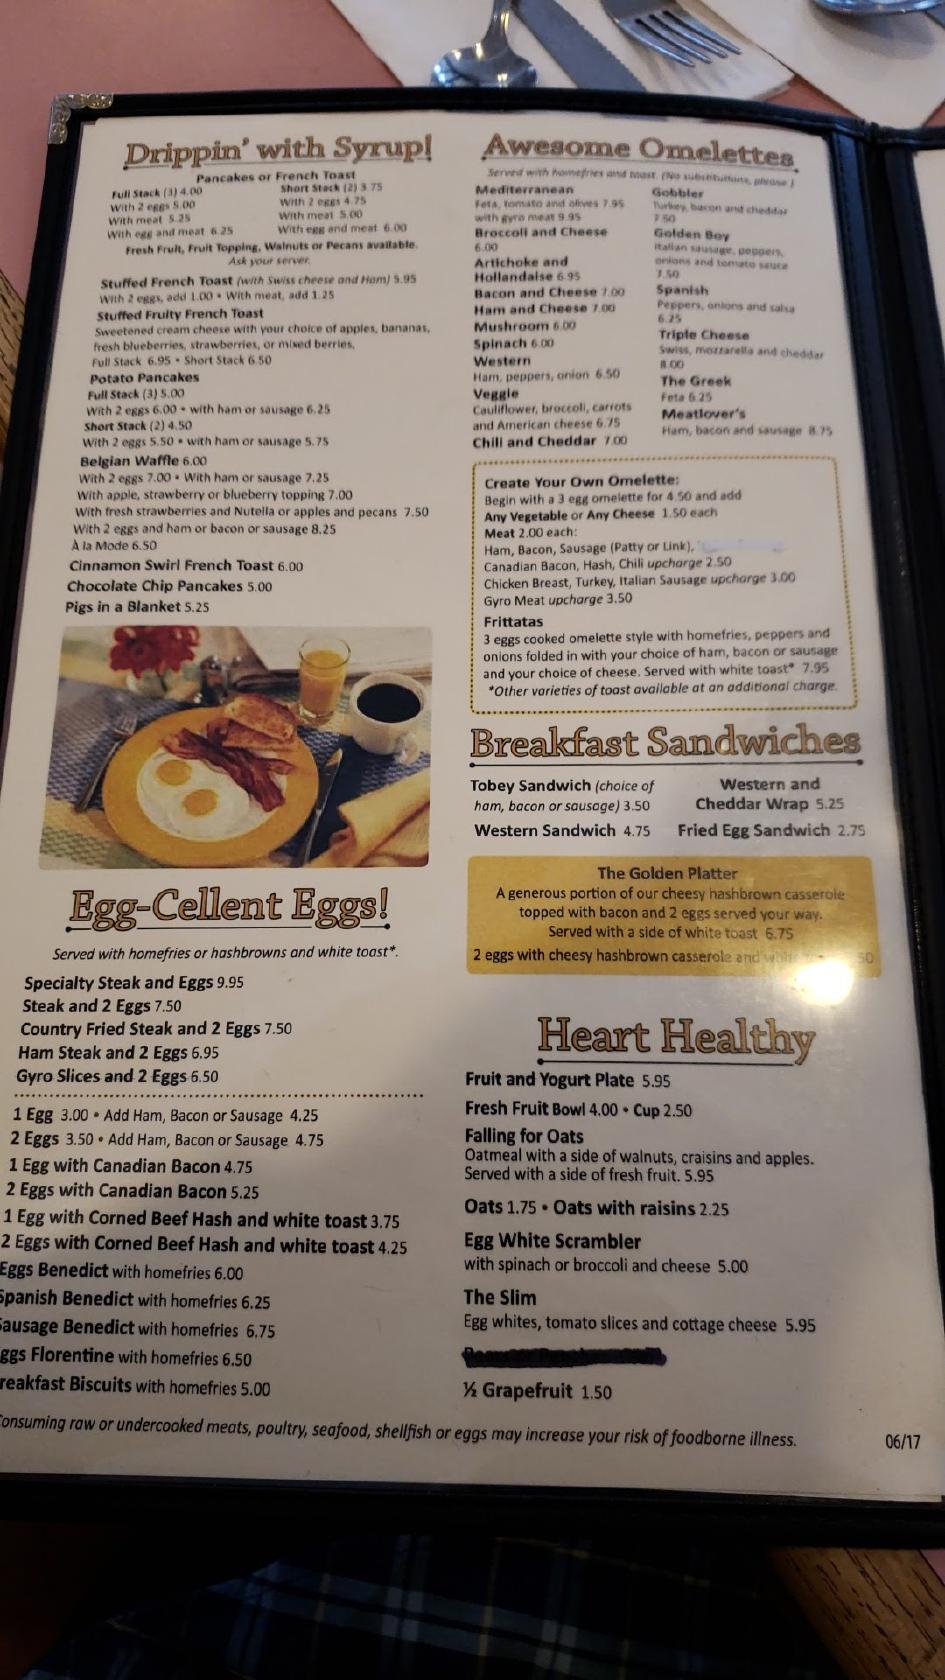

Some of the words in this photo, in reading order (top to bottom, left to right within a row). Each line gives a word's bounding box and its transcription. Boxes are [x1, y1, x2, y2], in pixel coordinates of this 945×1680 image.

[125, 138, 250, 168] Drippin'
[256, 136, 325, 159] with
[333, 133, 433, 163] Syrup!
[484, 133, 630, 157] Awesome
[639, 137, 795, 166] Omelettes
[197, 172, 254, 184] Pancakes
[258, 173, 271, 181] or
[276, 170, 318, 181] French
[324, 170, 355, 180] Toast
[476, 185, 574, 195] Mediterranean
[652, 187, 704, 199] Gobbler
[475, 227, 528, 238] Broccoli
[532, 227, 556, 237] and
[561, 227, 607, 237] Cheese
[654, 227, 701, 239] Golden
[705, 230, 730, 243] Boy
[101, 277, 147, 289] Stuffed
[151, 275, 194, 288] French
[200, 275, 233, 287] Toast
[237, 276, 263, 287] (with
[269, 276, 295, 286] Swiss
[298, 275, 334, 285] cheese
[338, 275, 358, 285] and
[361, 274, 390, 287] Ham)
[394, 274, 417, 285] 5.95
[475, 288, 515, 299] Bacon
[520, 286, 544, 298] and
[549, 286, 597, 298] Cheese
[603, 288, 625, 297] 7.00
[657, 284, 708, 297] Spanish
[97, 310, 142, 321] Stuffed
[146, 309, 181, 321] Fruity
[185, 307, 227, 320] French
[232, 308, 263, 319] Toast
[474, 320, 549, 333] Mushroom
[553, 321, 576, 330] 6.00
[659, 329, 696, 342] Triple
[701, 329, 749, 340] Cheese
[474, 337, 527, 352] Spinach
[531, 339, 554, 348] 6.00
[90, 374, 133, 384] Potato
[138, 372, 199, 383] Pancakes
[661, 375, 686, 387] The
[690, 376, 731, 386] Greek
[662, 408, 745, 420] Meatlover's
[473, 436, 502, 448] Chili
[508, 436, 533, 448] and
[538, 434, 596, 448] Cheddar
[606, 436, 627, 445] 7.00
[81, 455, 130, 469] Belgian
[135, 454, 179, 467] Waffle
[183, 456, 207, 466] 6.00
[485, 478, 530, 489] Create
[535, 477, 566, 488] Your
[571, 476, 603, 487] Own
[608, 473, 678, 487] Omelette:
[75, 507, 102, 518] With
[106, 506, 132, 517] fresh
[137, 506, 206, 517] strawberries
[210, 506, 230, 517] and
[235, 506, 274, 517] Nutella
[278, 508, 290, 516] or
[294, 505, 330, 519] apples
[334, 506, 354, 517] and
[359, 508, 397, 519] pecans
[405, 506, 429, 517] 7.50
[485, 528, 515, 539] Meat
[519, 528, 543, 538] 2.00
[547, 527, 576, 538] each:
[70, 560, 140, 571] Cinnamon
[145, 559, 180, 570] Swirl
[185, 559, 232, 571] French
[237, 560, 274, 571] Toast
[278, 562, 303, 571] 6.00
[67, 580, 137, 593] Chocolate
[142, 579, 173, 594] Chip
[178, 579, 242, 592] Pancakes
[248, 581, 272, 592] 5.00
[66, 601, 93, 616] Pigs
[98, 600, 109, 613] in
[115, 603, 122, 613] a
[128, 599, 181, 613] Blanket
[185, 601, 209, 612] 5.25
[485, 615, 543, 628] Frittatas
[484, 633, 490, 645] 3
[494, 636, 520, 648] eggs
[524, 632, 564, 645] cooked
[570, 632, 622, 644] omelette
[626, 631, 653, 644] style
[657, 630, 683, 642] with
[687, 629, 751, 641] homefries,
[755, 630, 804, 641] peppers
[808, 628, 830, 639] and
[470, 726, 639, 758] Breakfast
[647, 723, 862, 757] Sandwiches
[470, 780, 515, 794] Tobey
[519, 779, 591, 792] Sandwich
[596, 780, 637, 793] (choice
[642, 780, 654, 793] of
[720, 779, 785, 790] Western
[791, 777, 820, 790] and
[696, 797, 761, 810] Cheddar
[766, 798, 809, 812] Wrap
[816, 798, 843, 809] 5.25
[678, 823, 717, 837] Fried
[723, 824, 750, 839] Egg
[754, 823, 830, 837] Sandwich
[839, 825, 865, 836] 2.75
[598, 866, 625, 879] The
[629, 866, 683, 879] Golden
[688, 866, 738, 879] Platter
[70, 887, 282, 931] Egg-Cellent
[291, 887, 389, 929] Eggs!
[52, 947, 95, 960] Served
[99, 947, 124, 960] with
[129, 947, 191, 961] homefries
[194, 950, 208, 960] or
[211, 946, 287, 959] hashbrowns
[291, 945, 314, 958] and
[318, 946, 352, 958] white
[25, 975, 94, 992] Specialty
[98, 975, 140, 990] Steak
[145, 975, 174, 990] and
[179, 976, 213, 992] Eggs
[218, 976, 243, 989] 9.95
[538, 1017, 651, 1052] Heart
[661, 1017, 816, 1065] Healthy
[466, 1071, 501, 1086] Fruit
[507, 1070, 535, 1087] and
[540, 1071, 591, 1089] Yogurt
[596, 1072, 634, 1088] Plate
[643, 1074, 670, 1088] 5.95
[466, 1127, 515, 1146] Falling
[520, 1128, 543, 1143] for
[547, 1129, 584, 1144] Oats
[6, 1182, 15, 1196] 2
[20, 1182, 54, 1200] Eggs
[59, 1182, 94, 1197] with
[99, 1182, 172, 1199] Canadian
[178, 1183, 226, 1199] Bacon
[231, 1185, 259, 1200] 5.25
[465, 1232, 493, 1251] Egg
[499, 1231, 550, 1249] White
[556, 1232, 641, 1249] Scrambler
[0, 1261, 33, 1280] Eggs
[38, 1262, 109, 1278] Benedict
[113, 1264, 140, 1279] with
[145, 1264, 210, 1280] homefries
[215, 1266, 243, 1280] 6.00
[464, 1288, 494, 1306] The
[500, 1288, 536, 1306] Slim
[483, 1381, 572, 1400] Grapefruit
[582, 1385, 612, 1400] 1.50
[886, 1434, 920, 1449] 06/17
